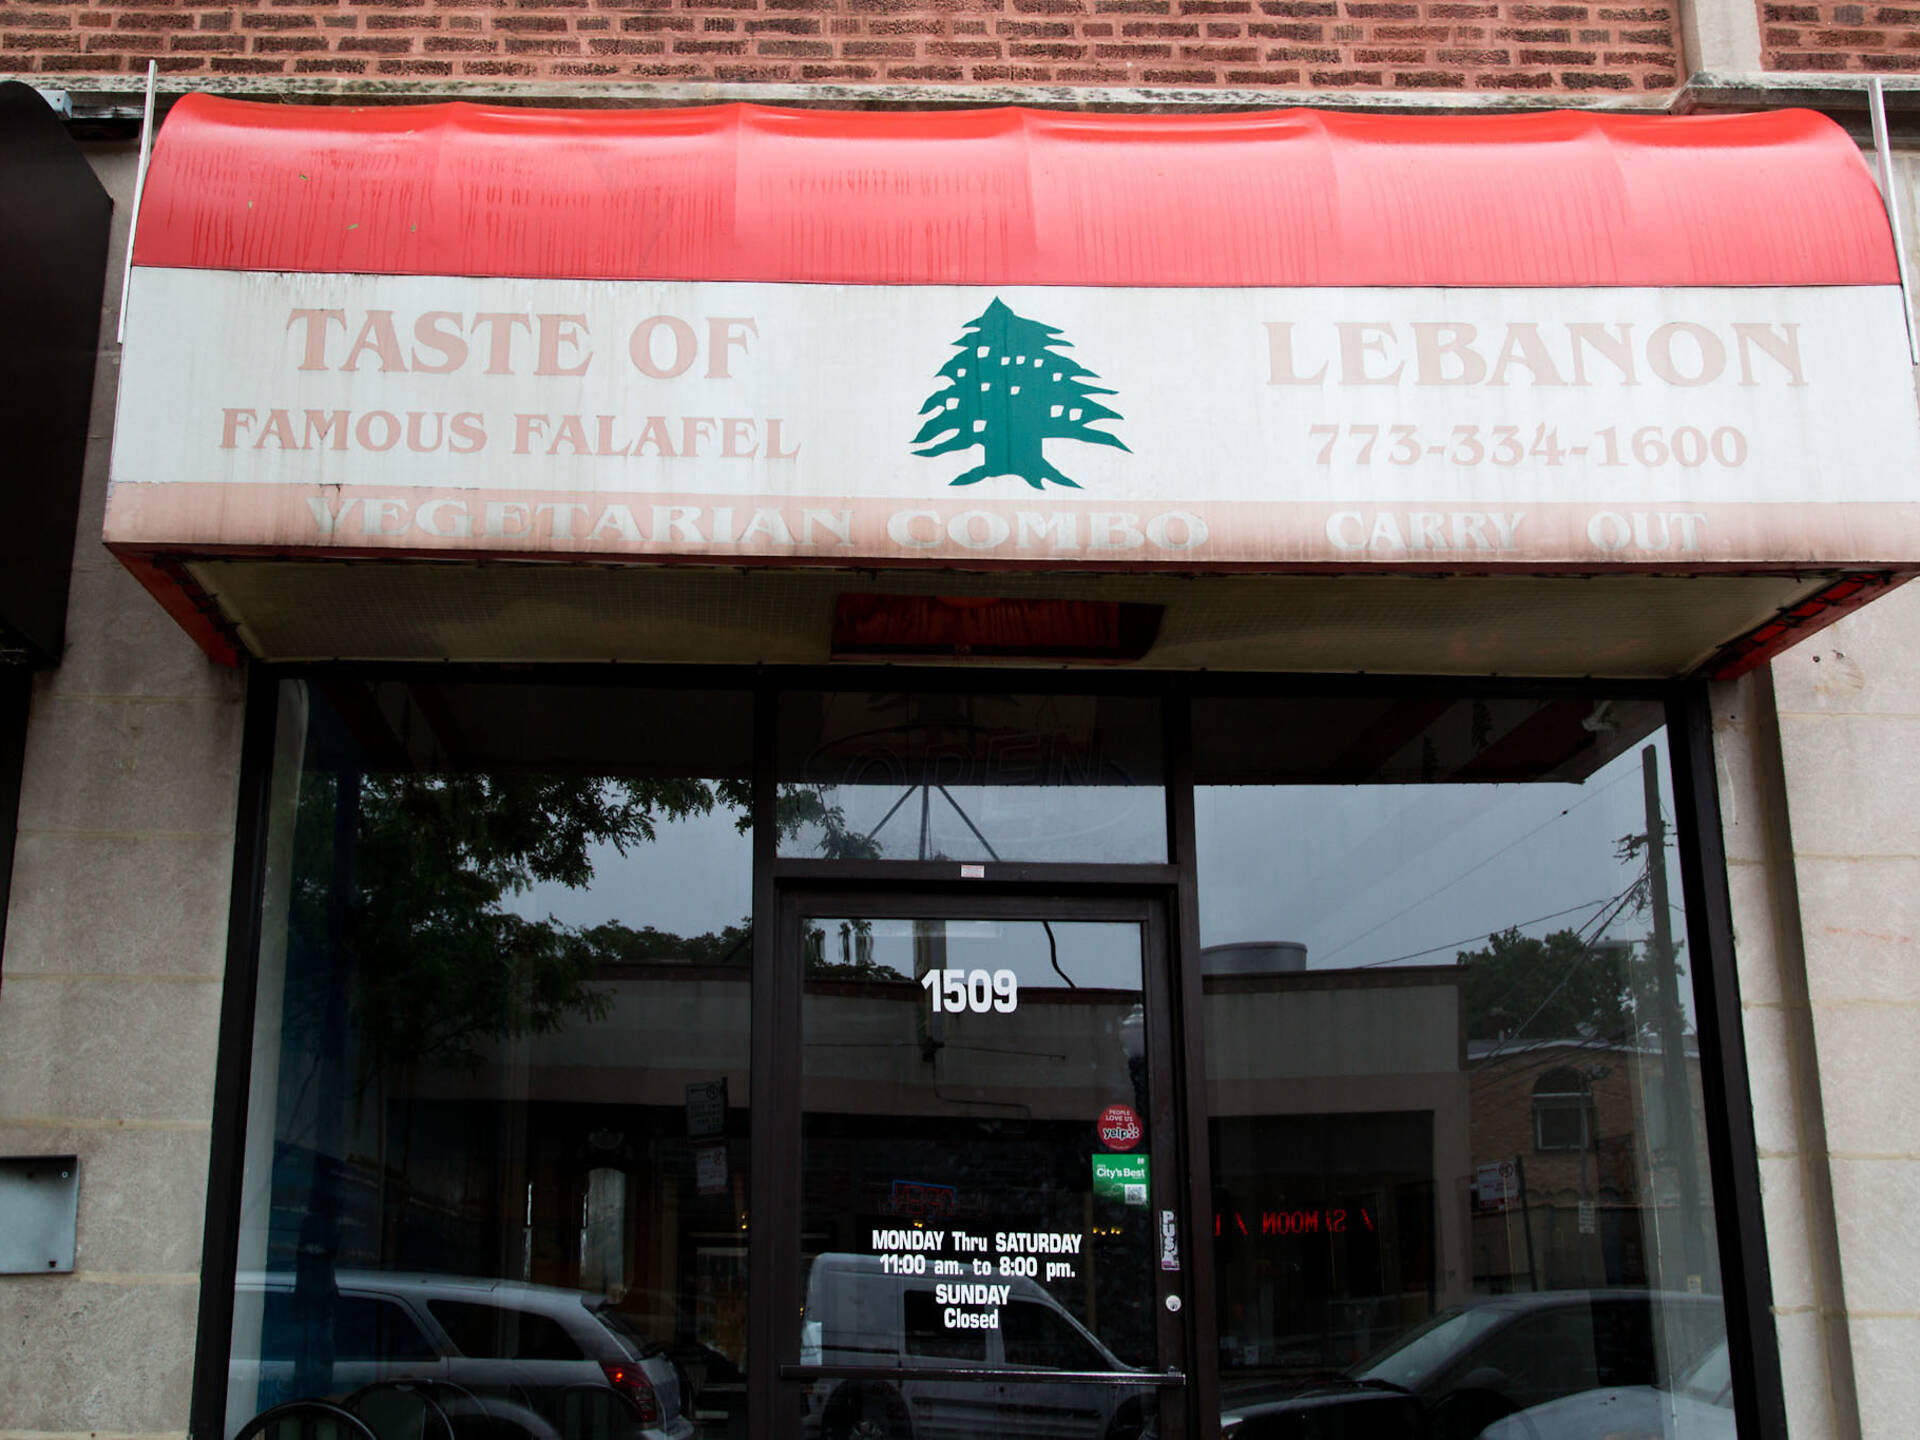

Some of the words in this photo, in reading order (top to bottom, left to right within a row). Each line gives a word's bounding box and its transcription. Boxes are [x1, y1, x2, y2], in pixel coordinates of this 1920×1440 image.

[286, 308, 594, 377] TASTE
[629, 314, 759, 380] OF
[1262, 321, 1809, 388] LEBANON
[220, 407, 488, 454] FAMOUS
[513, 413, 802, 459] FALAFEL
[1309, 423, 1748, 468] 773-334-1600
[306, 496, 855, 547] VEGETARIAN
[887, 509, 1209, 551] COMBO
[1326, 510, 1526, 552] CARRY
[1587, 510, 1710, 553] OUT
[921, 968, 1018, 1013] 1509
[1103, 1127, 1128, 1141] yelp
[1096, 1168, 1123, 1179] City's
[1123, 1168, 1145, 1177] Best
[872, 1230, 945, 1250] MONDAY
[952, 1231, 988, 1251] Thru
[995, 1233, 1082, 1254] SATURDAY
[879, 1254, 926, 1274] 11:00
[934, 1260, 964, 1276] am.
[972, 1258, 992, 1276] to
[999, 1256, 1038, 1277] 8:00
[1046, 1262, 1076, 1282] pm.
[935, 1284, 1011, 1305] SUNDAY
[944, 1308, 999, 1329] Closed
